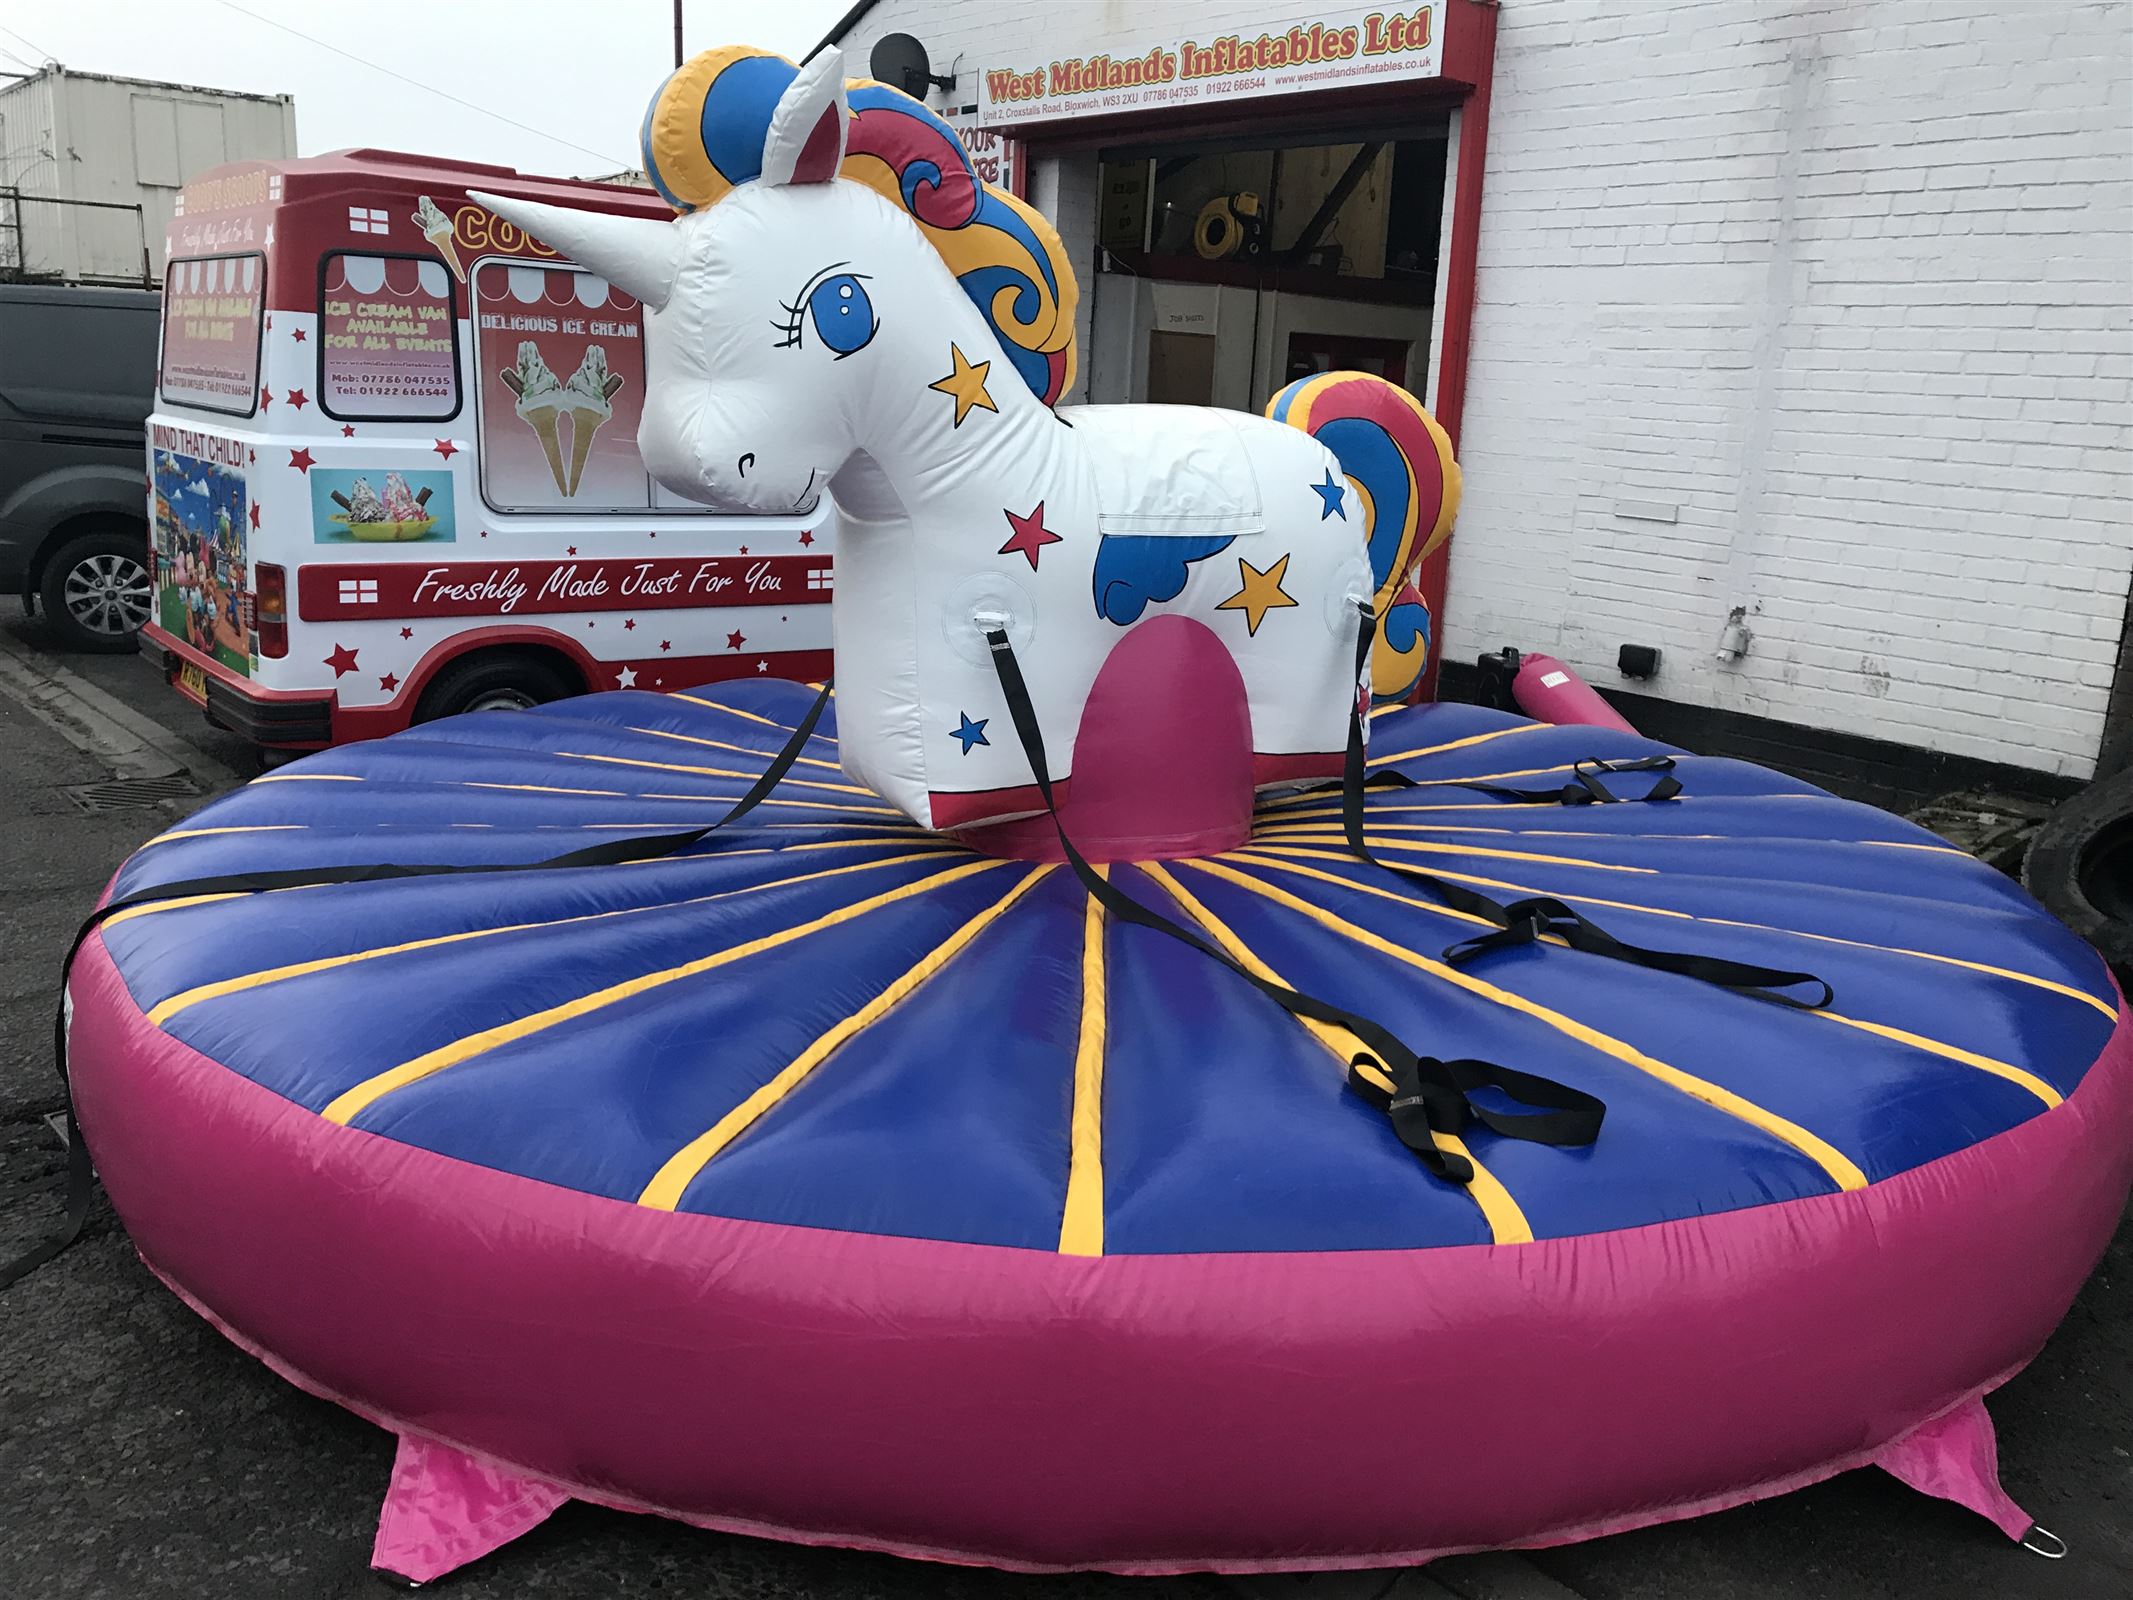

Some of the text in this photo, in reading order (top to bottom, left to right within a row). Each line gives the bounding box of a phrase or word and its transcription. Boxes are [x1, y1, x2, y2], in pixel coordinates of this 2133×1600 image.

[986, 6, 1432, 103] West Midlands Inflatables Ltd
[983, 111, 997, 121] Unit
[1006, 105, 1040, 118] Croxstalls
[1042, 103, 1062, 115] Road,
[1065, 99, 1101, 111] Bloxwich,
[1103, 95, 1121, 106] WS3
[1122, 93, 1139, 105] 2XU
[1143, 90, 1167, 102] 07786
[1168, 85, 1199, 99] 047535
[1206, 80, 1232, 94] 01922
[1233, 77, 1266, 92] 666544
[1275, 56, 1431, 86] www.westmidlandsinflatables.co.uk
[325, 301, 447, 320] ICE CREAM VAN
[346, 318, 428, 335] AVAILABLE
[480, 311, 638, 338] DELICIOUS ICE CREAM
[325, 334, 452, 352] FOR ALL EVENTS
[332, 374, 450, 385] Mob: 07786 047535
[336, 386, 448, 396] Tel: 01922 666544
[153, 423, 245, 468] MIND THAT CHILD!
[413, 561, 782, 613] Freshly Made Just For You
